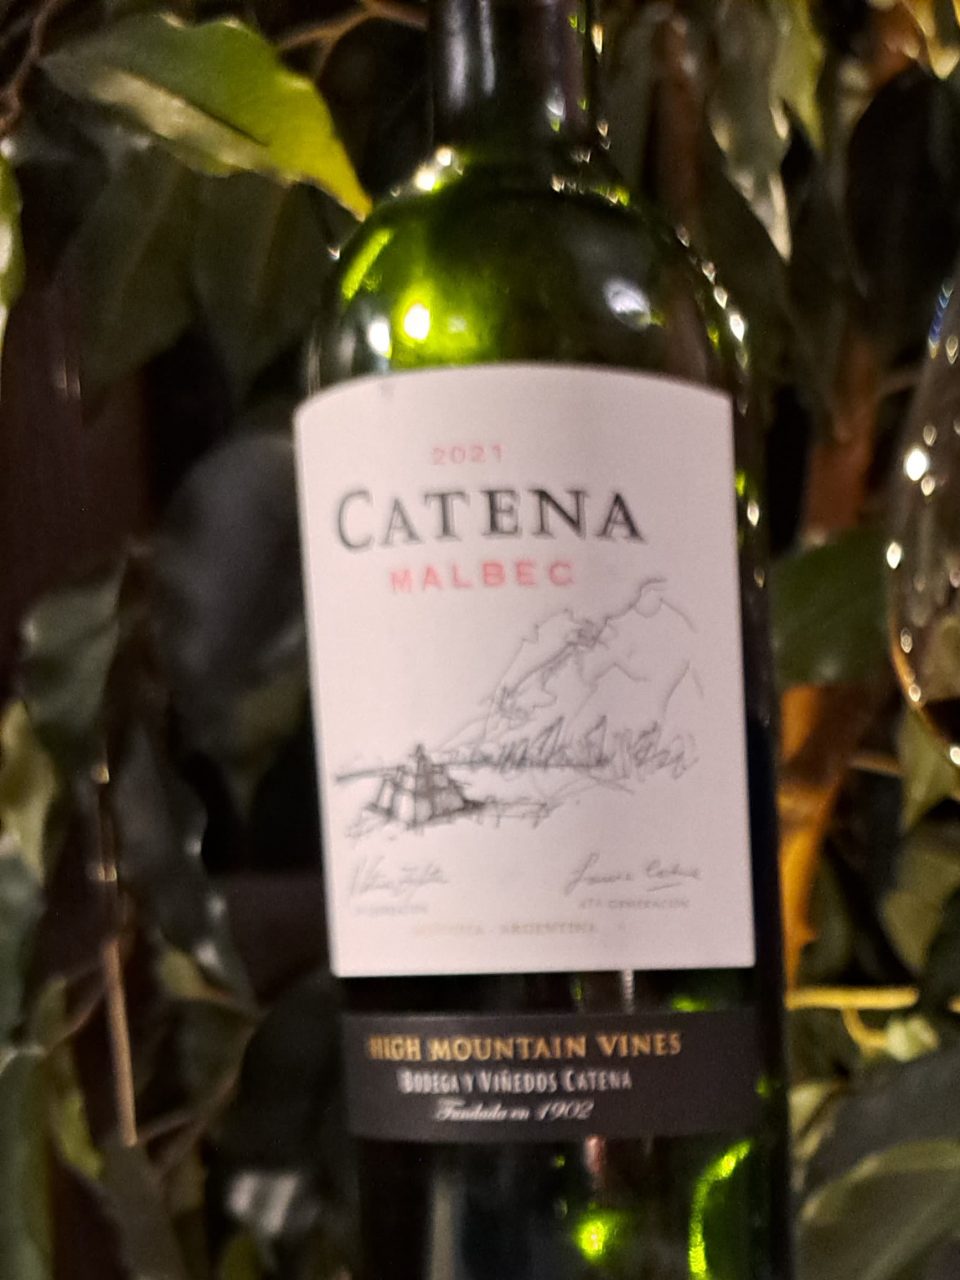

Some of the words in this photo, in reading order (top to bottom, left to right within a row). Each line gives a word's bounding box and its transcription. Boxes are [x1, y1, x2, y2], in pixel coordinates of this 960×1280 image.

[430, 443, 506, 466] 2021
[336, 486, 647, 554] CATENA
[389, 559, 575, 594] MALBEC
[368, 1035, 421, 1062] HIGH
[427, 1034, 587, 1062] MOUNTAIN
[597, 1031, 682, 1058] VINES
[398, 1068, 460, 1094] BODEGA
[560, 1068, 633, 1092] CATENA
[536, 1099, 595, 1121] 1902
